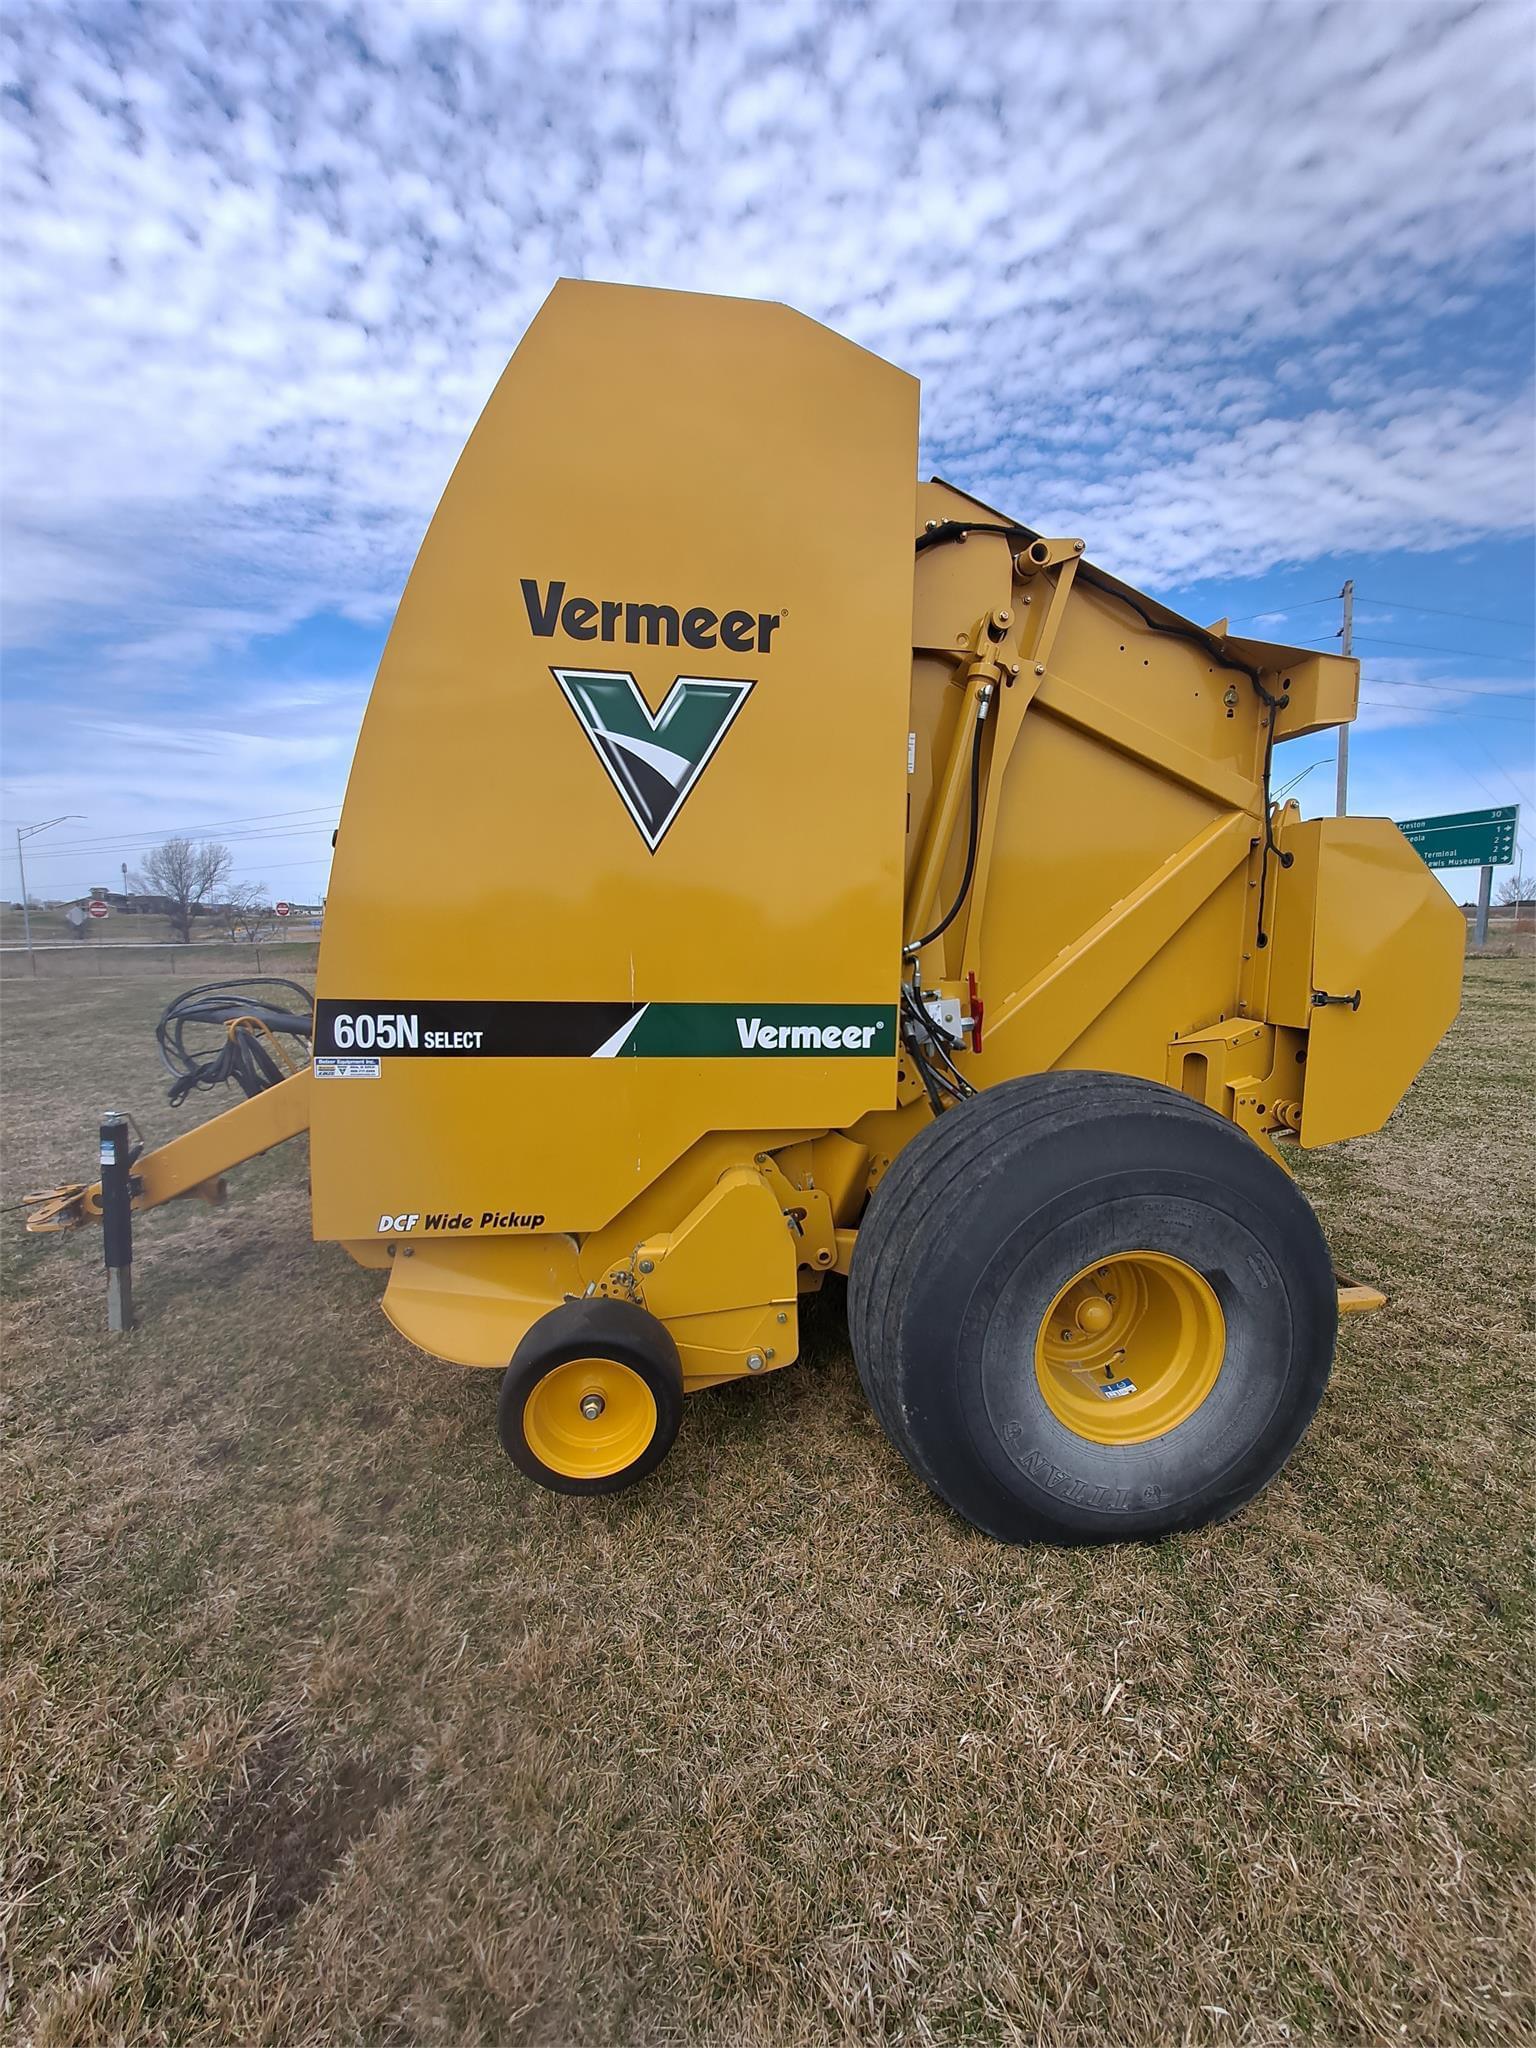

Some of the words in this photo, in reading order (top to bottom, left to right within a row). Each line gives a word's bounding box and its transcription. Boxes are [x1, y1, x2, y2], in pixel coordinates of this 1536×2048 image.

[1398, 821, 1426, 830] Creston
[1491, 810, 1502, 819] 30
[1424, 849, 1457, 859] Terminal
[1448, 857, 1481, 866] Museum
[333, 1014, 419, 1049] 605N
[424, 1031, 484, 1049] SELECT
[378, 1213, 420, 1233] DCF
[425, 1213, 473, 1230] Wide
[480, 1211, 546, 1230] Pickup
[1019, 1450, 1131, 1511] TITAN
